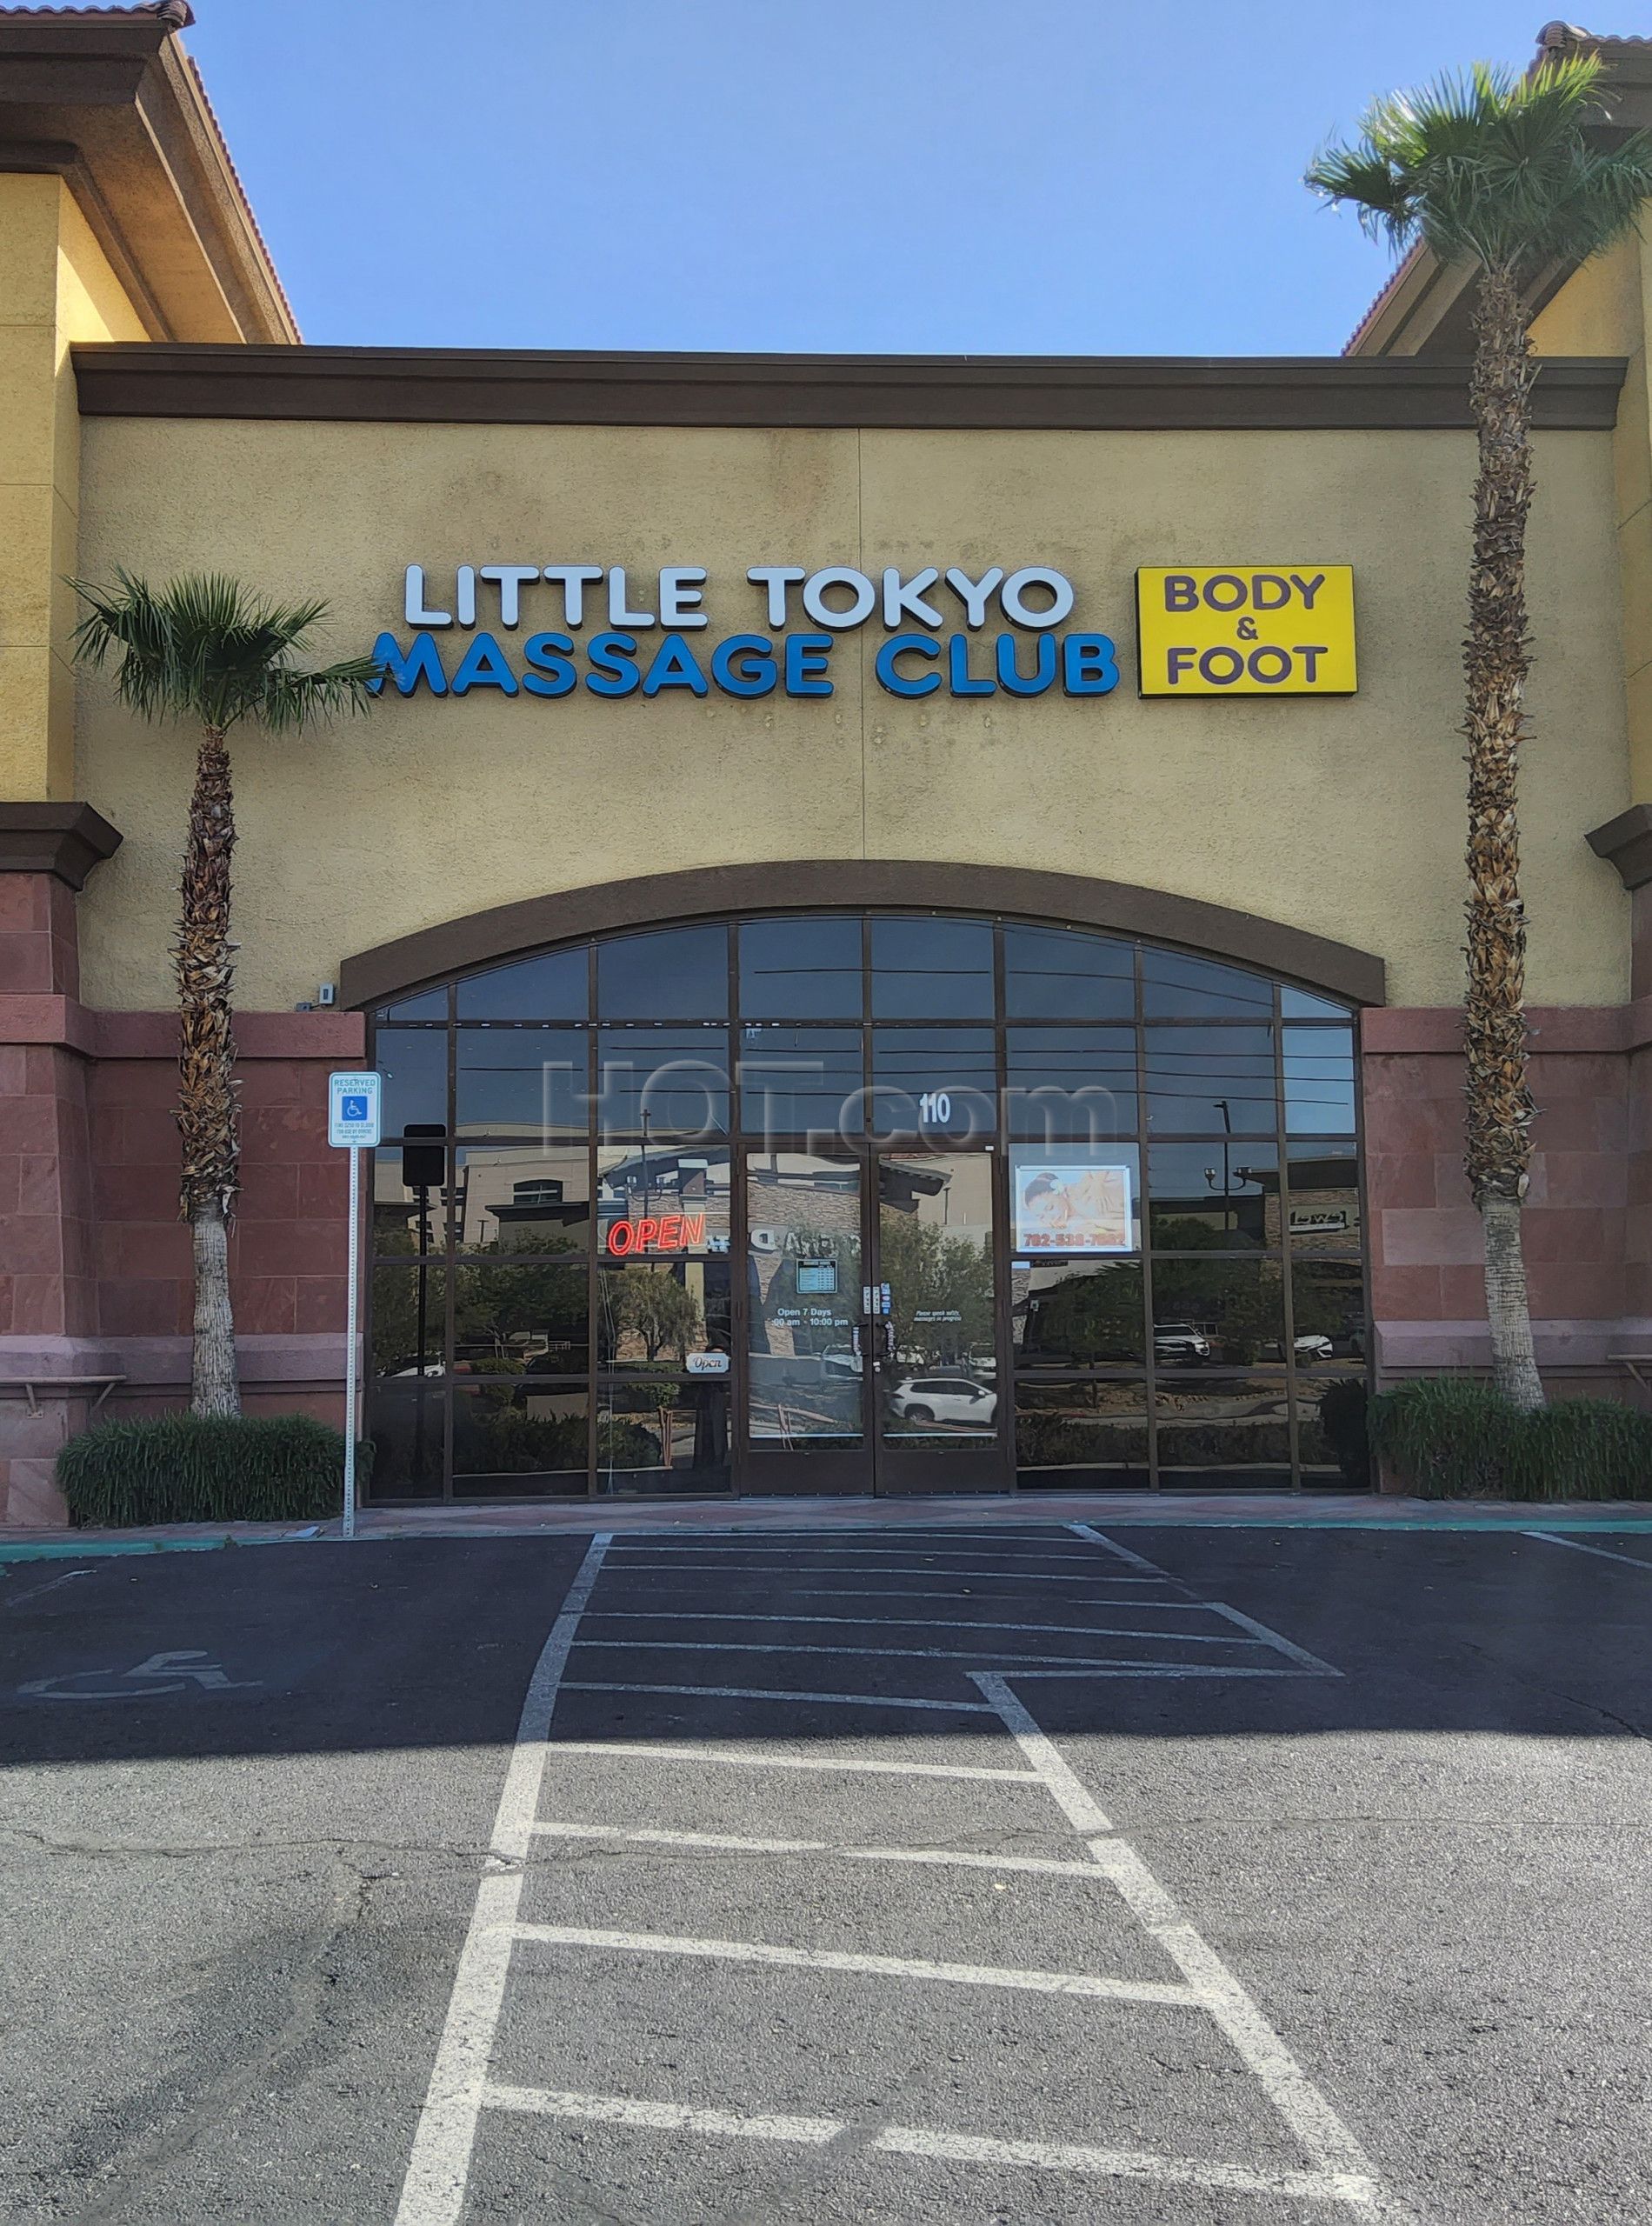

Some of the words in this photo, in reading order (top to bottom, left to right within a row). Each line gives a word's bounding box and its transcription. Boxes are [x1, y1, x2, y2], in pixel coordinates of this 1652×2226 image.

[404, 563, 709, 630] LITTLE
[746, 565, 1075, 632] TOKYO
[1164, 574, 1325, 612] BODY
[1236, 616, 1258, 640] &
[369, 631, 835, 699] MASSAGE
[875, 633, 1120, 699] CLUB
[1167, 646, 1329, 684] FOOT
[919, 1093, 951, 1123] 110
[609, 1214, 703, 1256] OPEN
[777, 1308, 801, 1317] Open
[803, 1308, 809, 1316] 7
[810, 1308, 832, 1317] Days
[809, 1317, 832, 1326] 10:00
[834, 1318, 849, 1328] pm
[694, 1356, 722, 1370] Open
